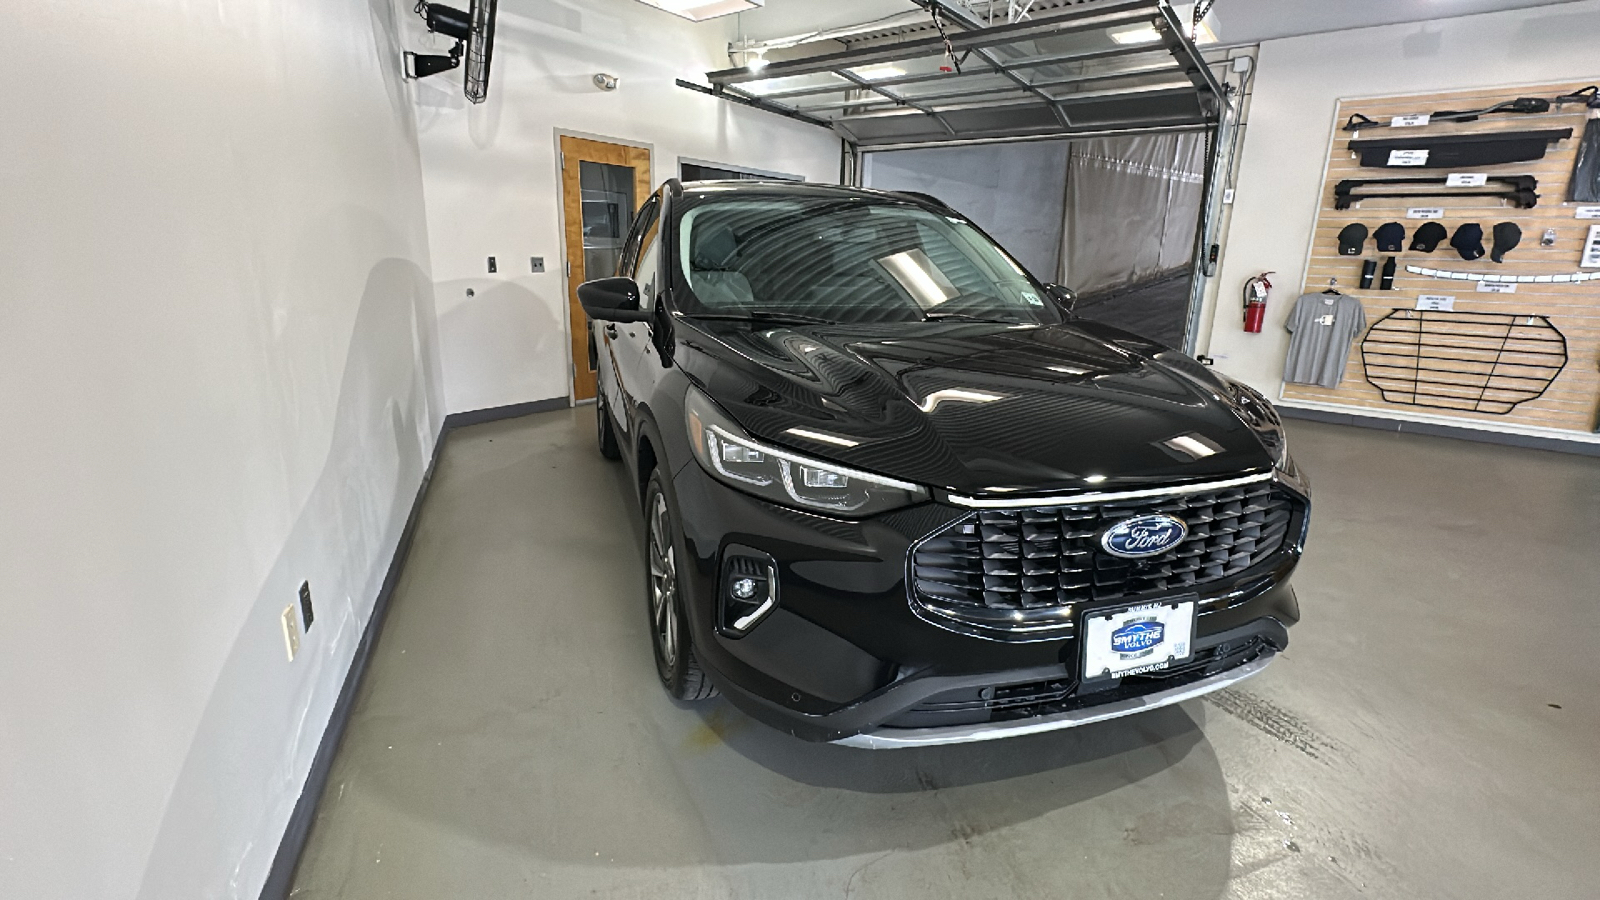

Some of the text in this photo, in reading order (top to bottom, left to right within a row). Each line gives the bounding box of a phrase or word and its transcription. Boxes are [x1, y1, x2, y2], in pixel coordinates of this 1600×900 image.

[1125, 526, 1173, 549] Ford
[1113, 631, 1161, 646] SMYTHE
[1124, 639, 1153, 649] VOLVO
